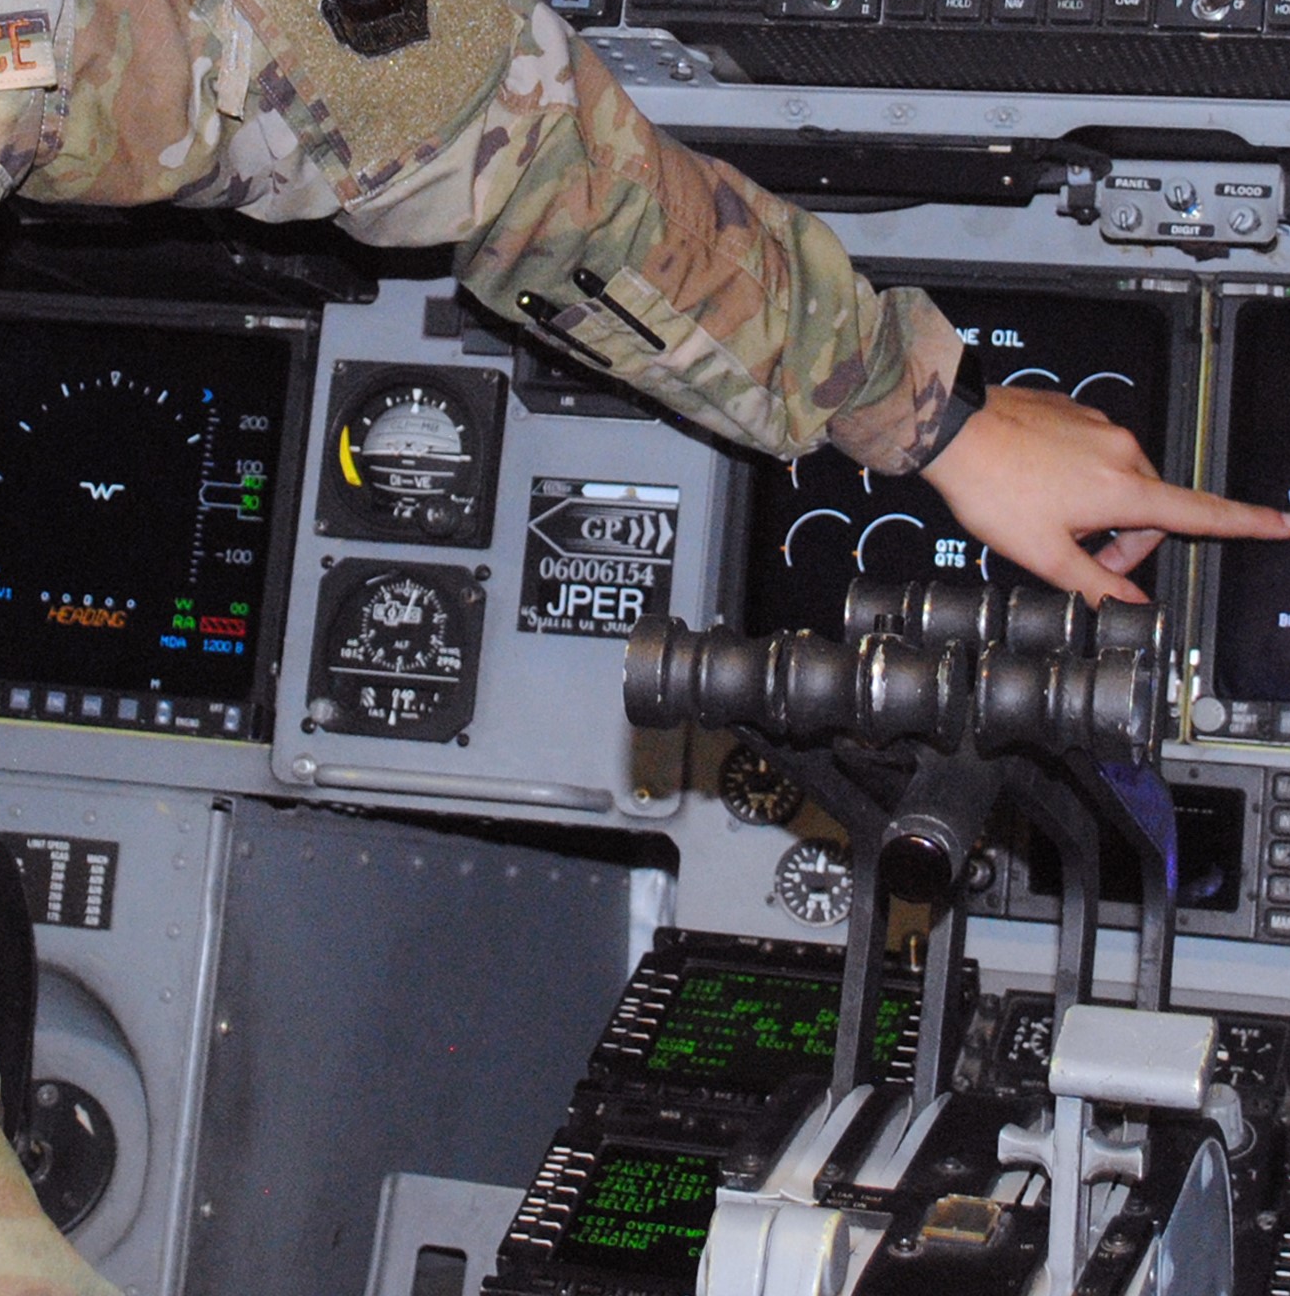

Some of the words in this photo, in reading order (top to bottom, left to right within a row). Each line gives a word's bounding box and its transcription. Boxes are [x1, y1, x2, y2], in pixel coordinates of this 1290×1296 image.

[1114, 177, 1151, 190] PANEL
[1223, 184, 1264, 197] FLOOD
[1170, 224, 1201, 237] DIGIT
[992, 329, 1024, 347] OIL
[239, 415, 269, 431] 200
[236, 459, 264, 475] 100
[581, 516, 622, 540] GP
[935, 539, 967, 553] QTY
[935, 553, 966, 568] QTS
[539, 556, 654, 586] 06006154
[546, 583, 644, 621] JPER
[47, 605, 126, 628] HEADING
[173, 615, 196, 630] RA
[160, 635, 187, 649] MDA
[203, 639, 232, 653] 1200
[626, 1220, 707, 1238] OVERTEMP
